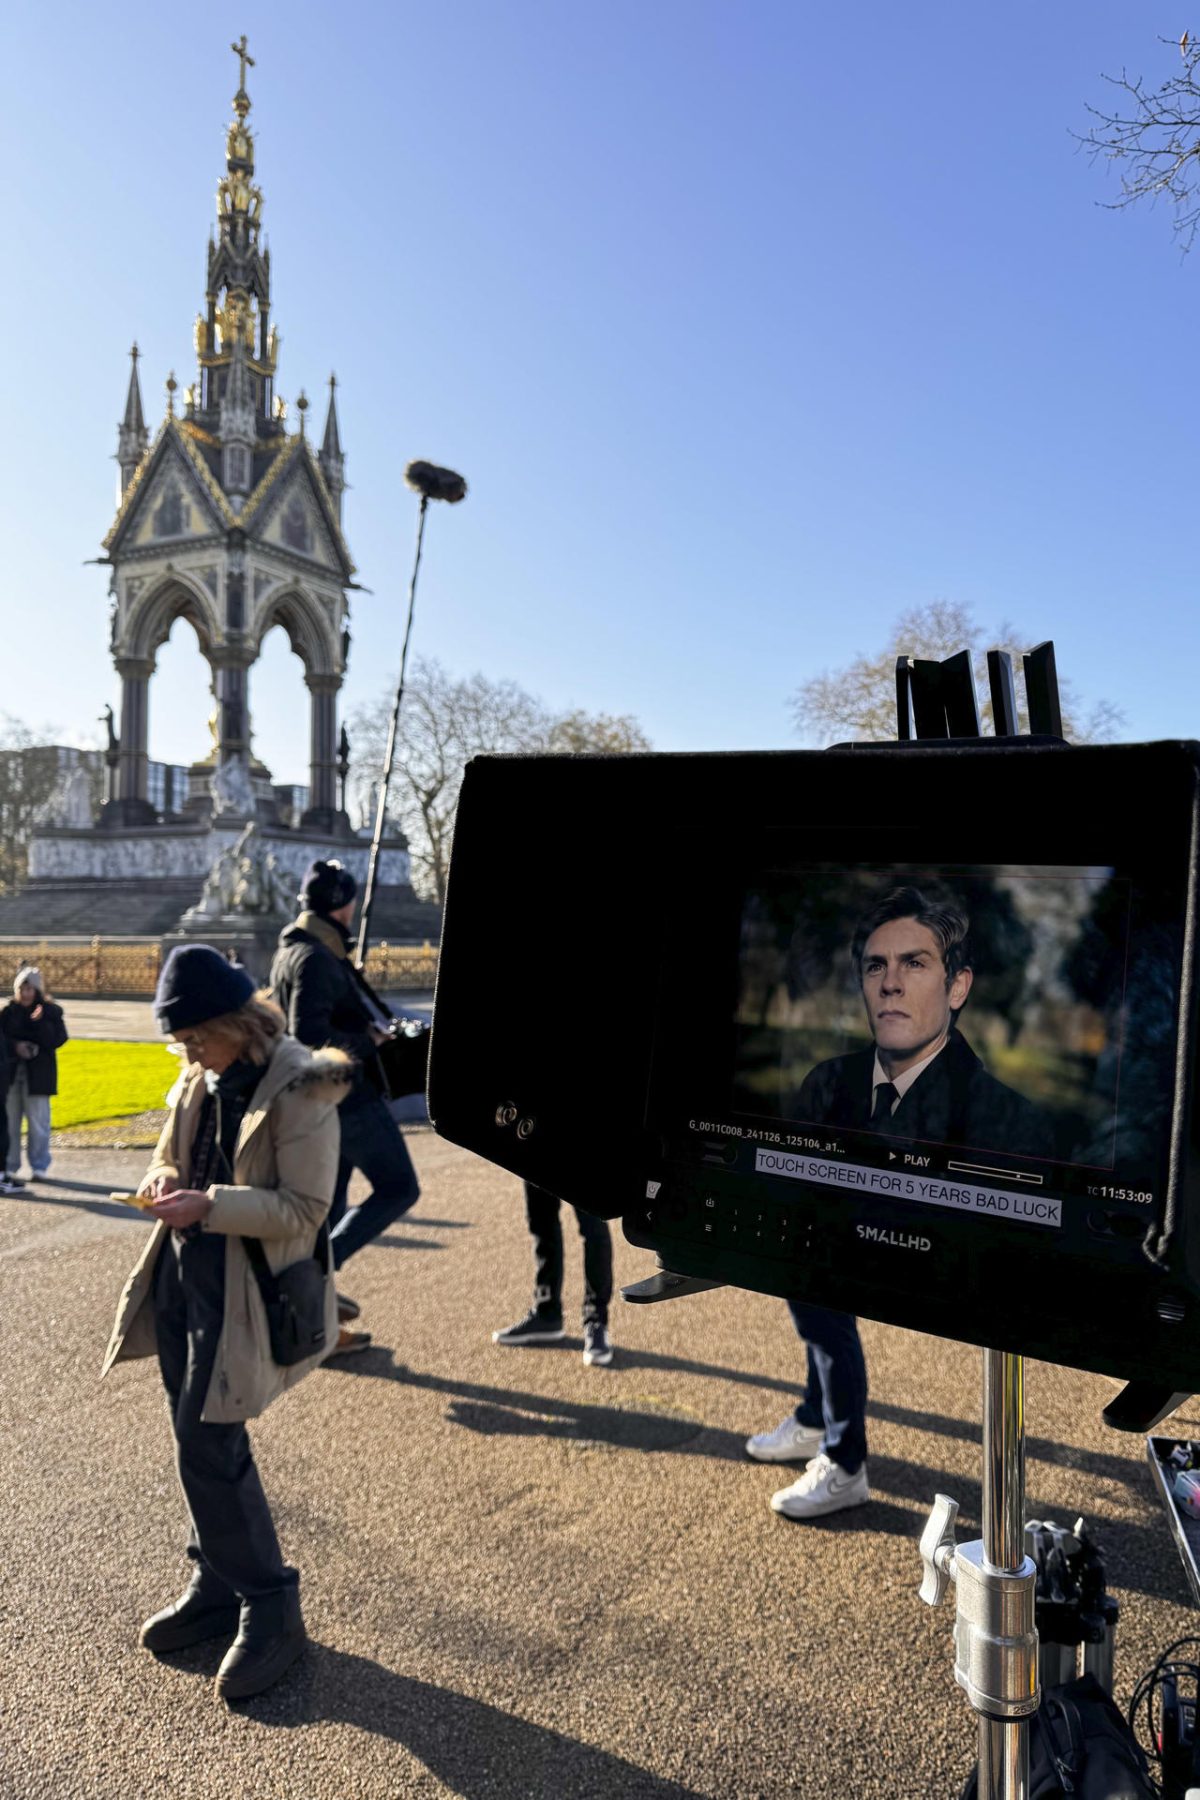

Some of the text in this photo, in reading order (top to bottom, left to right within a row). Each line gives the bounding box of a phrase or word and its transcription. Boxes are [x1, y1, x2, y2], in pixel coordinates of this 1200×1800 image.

[904, 1154, 931, 1167] PLAY
[759, 1153, 1059, 1220] TOUCH SCREEN FOR 5 YEARS BAD LUCK
[1100, 1186, 1153, 1204] 11:53:09
[856, 1224, 931, 1252] SMALLHD
